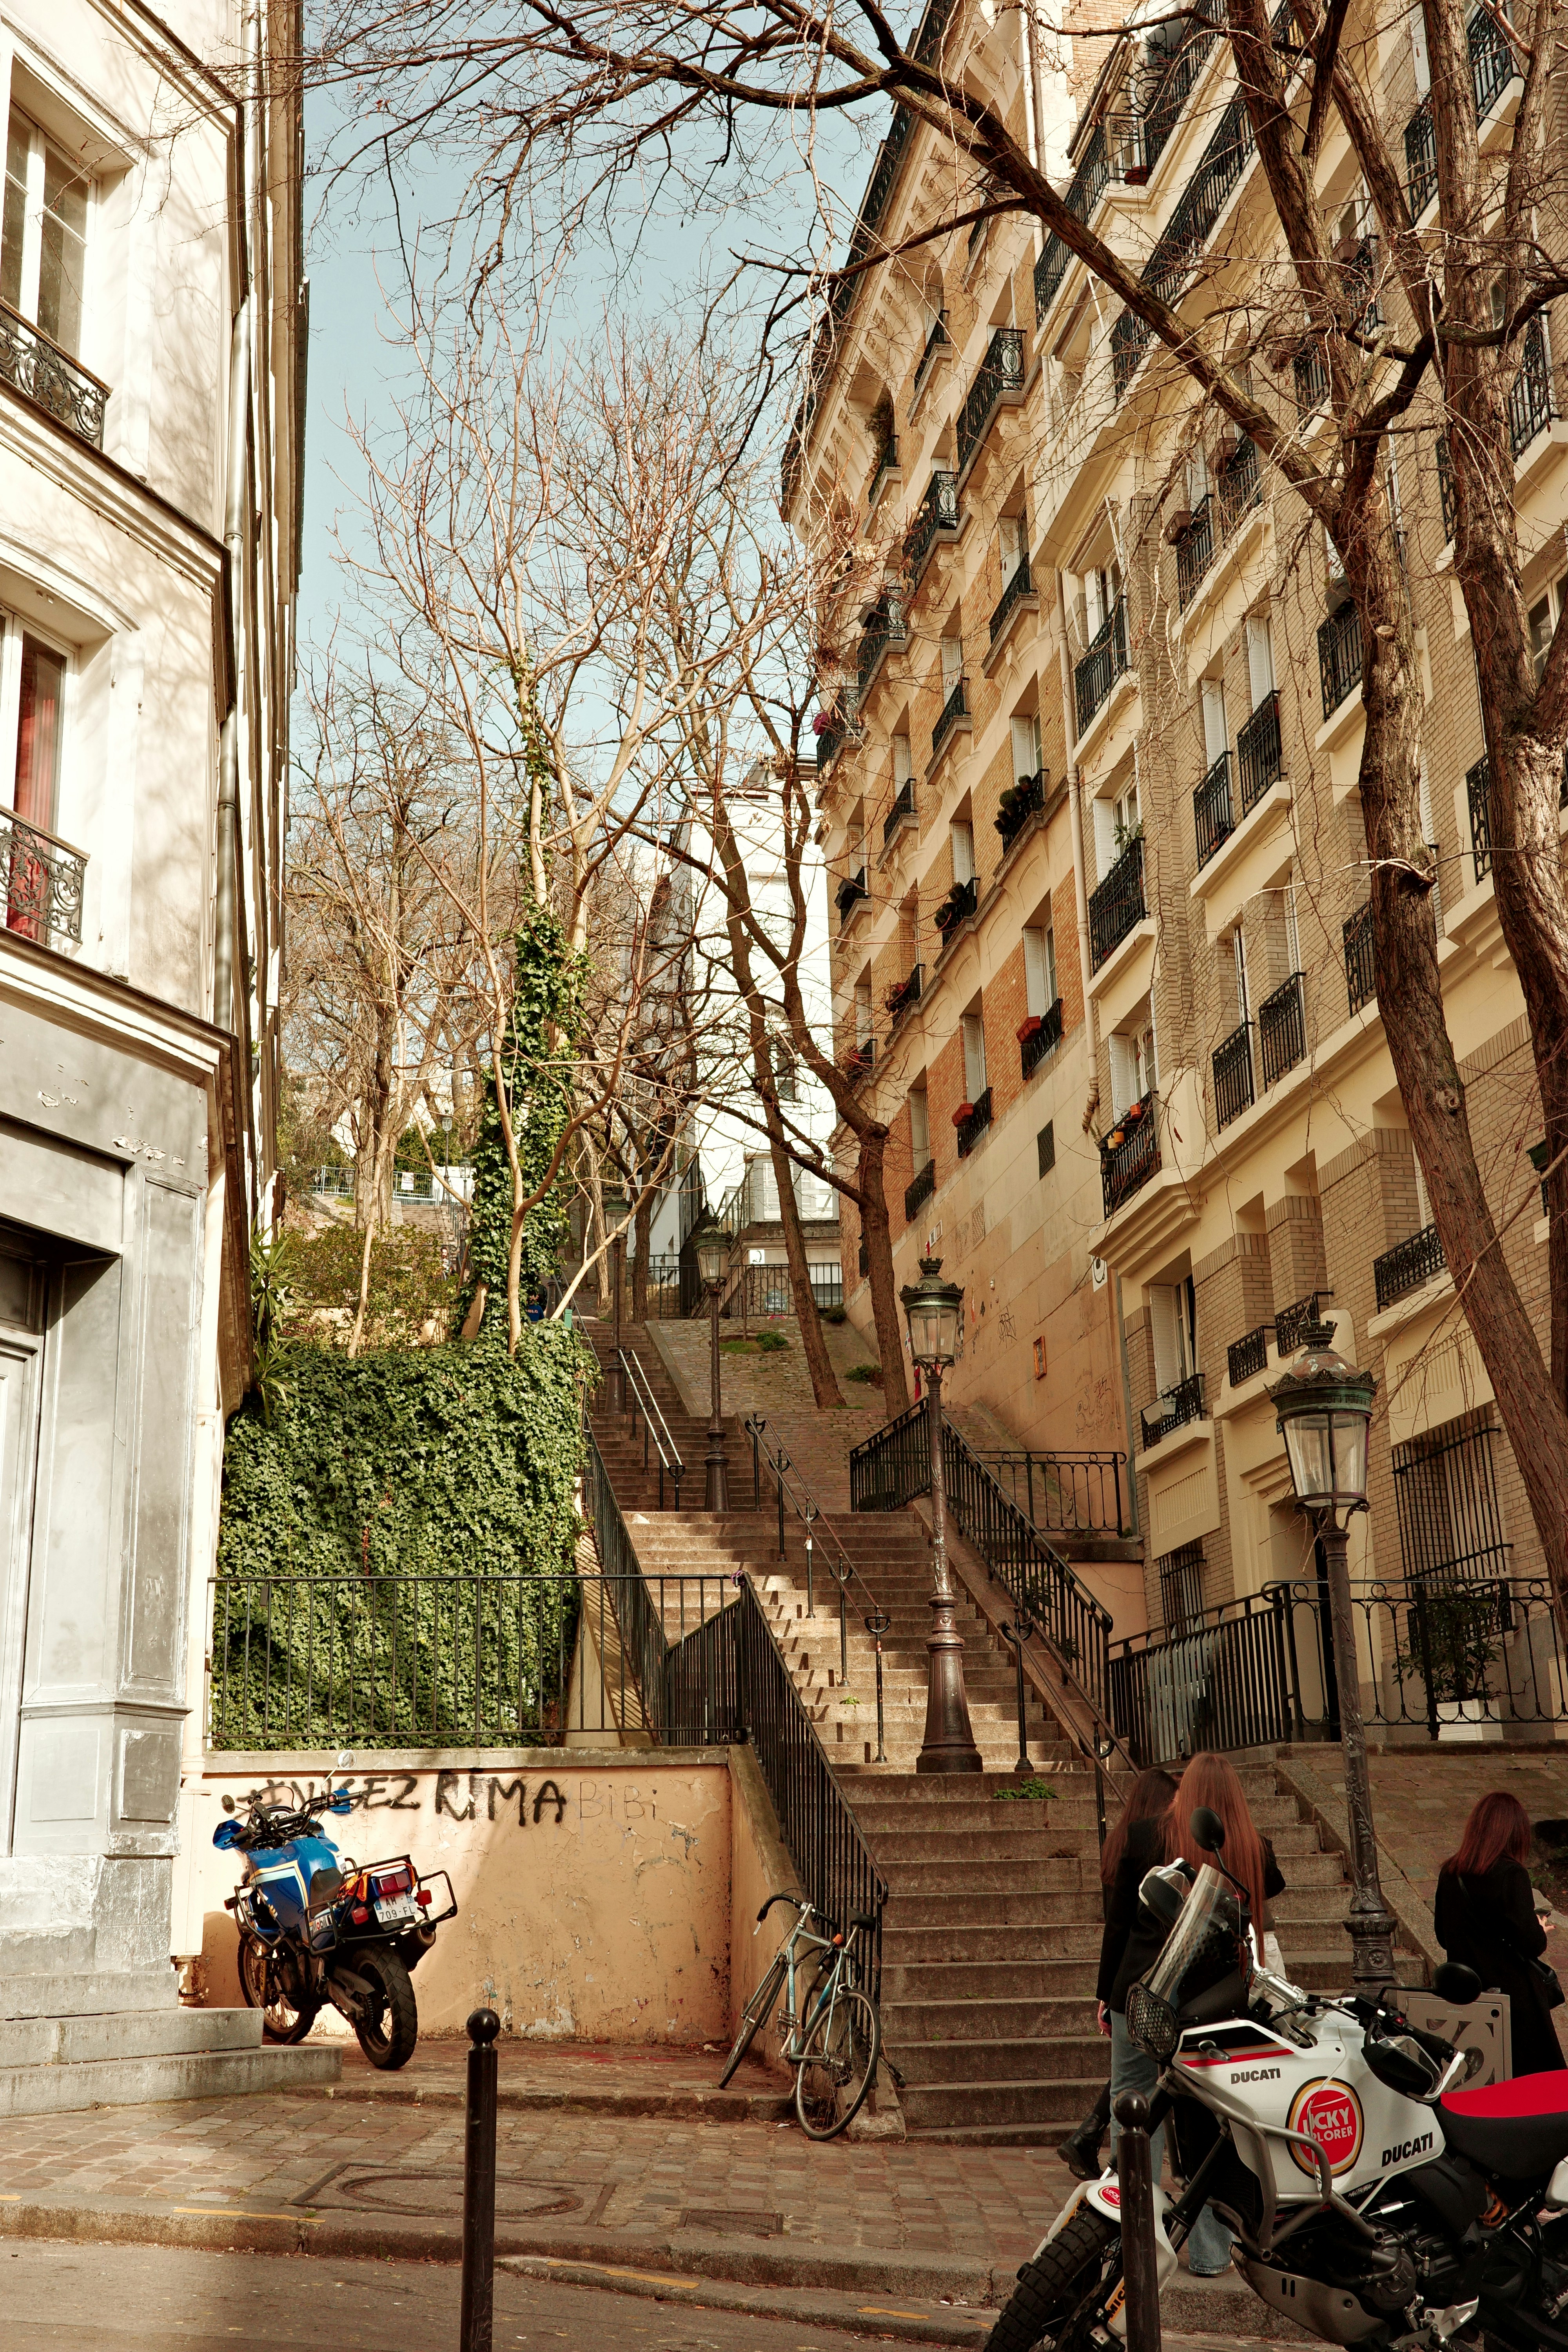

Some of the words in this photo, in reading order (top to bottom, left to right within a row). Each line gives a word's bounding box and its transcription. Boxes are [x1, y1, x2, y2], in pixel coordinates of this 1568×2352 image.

[1230, 2068, 1281, 2084] DUCATI
[1306, 2125, 1353, 2149] PLORER
[1381, 2131, 1433, 2167] DUCATI
[1108, 2285, 1125, 2318] MIC
